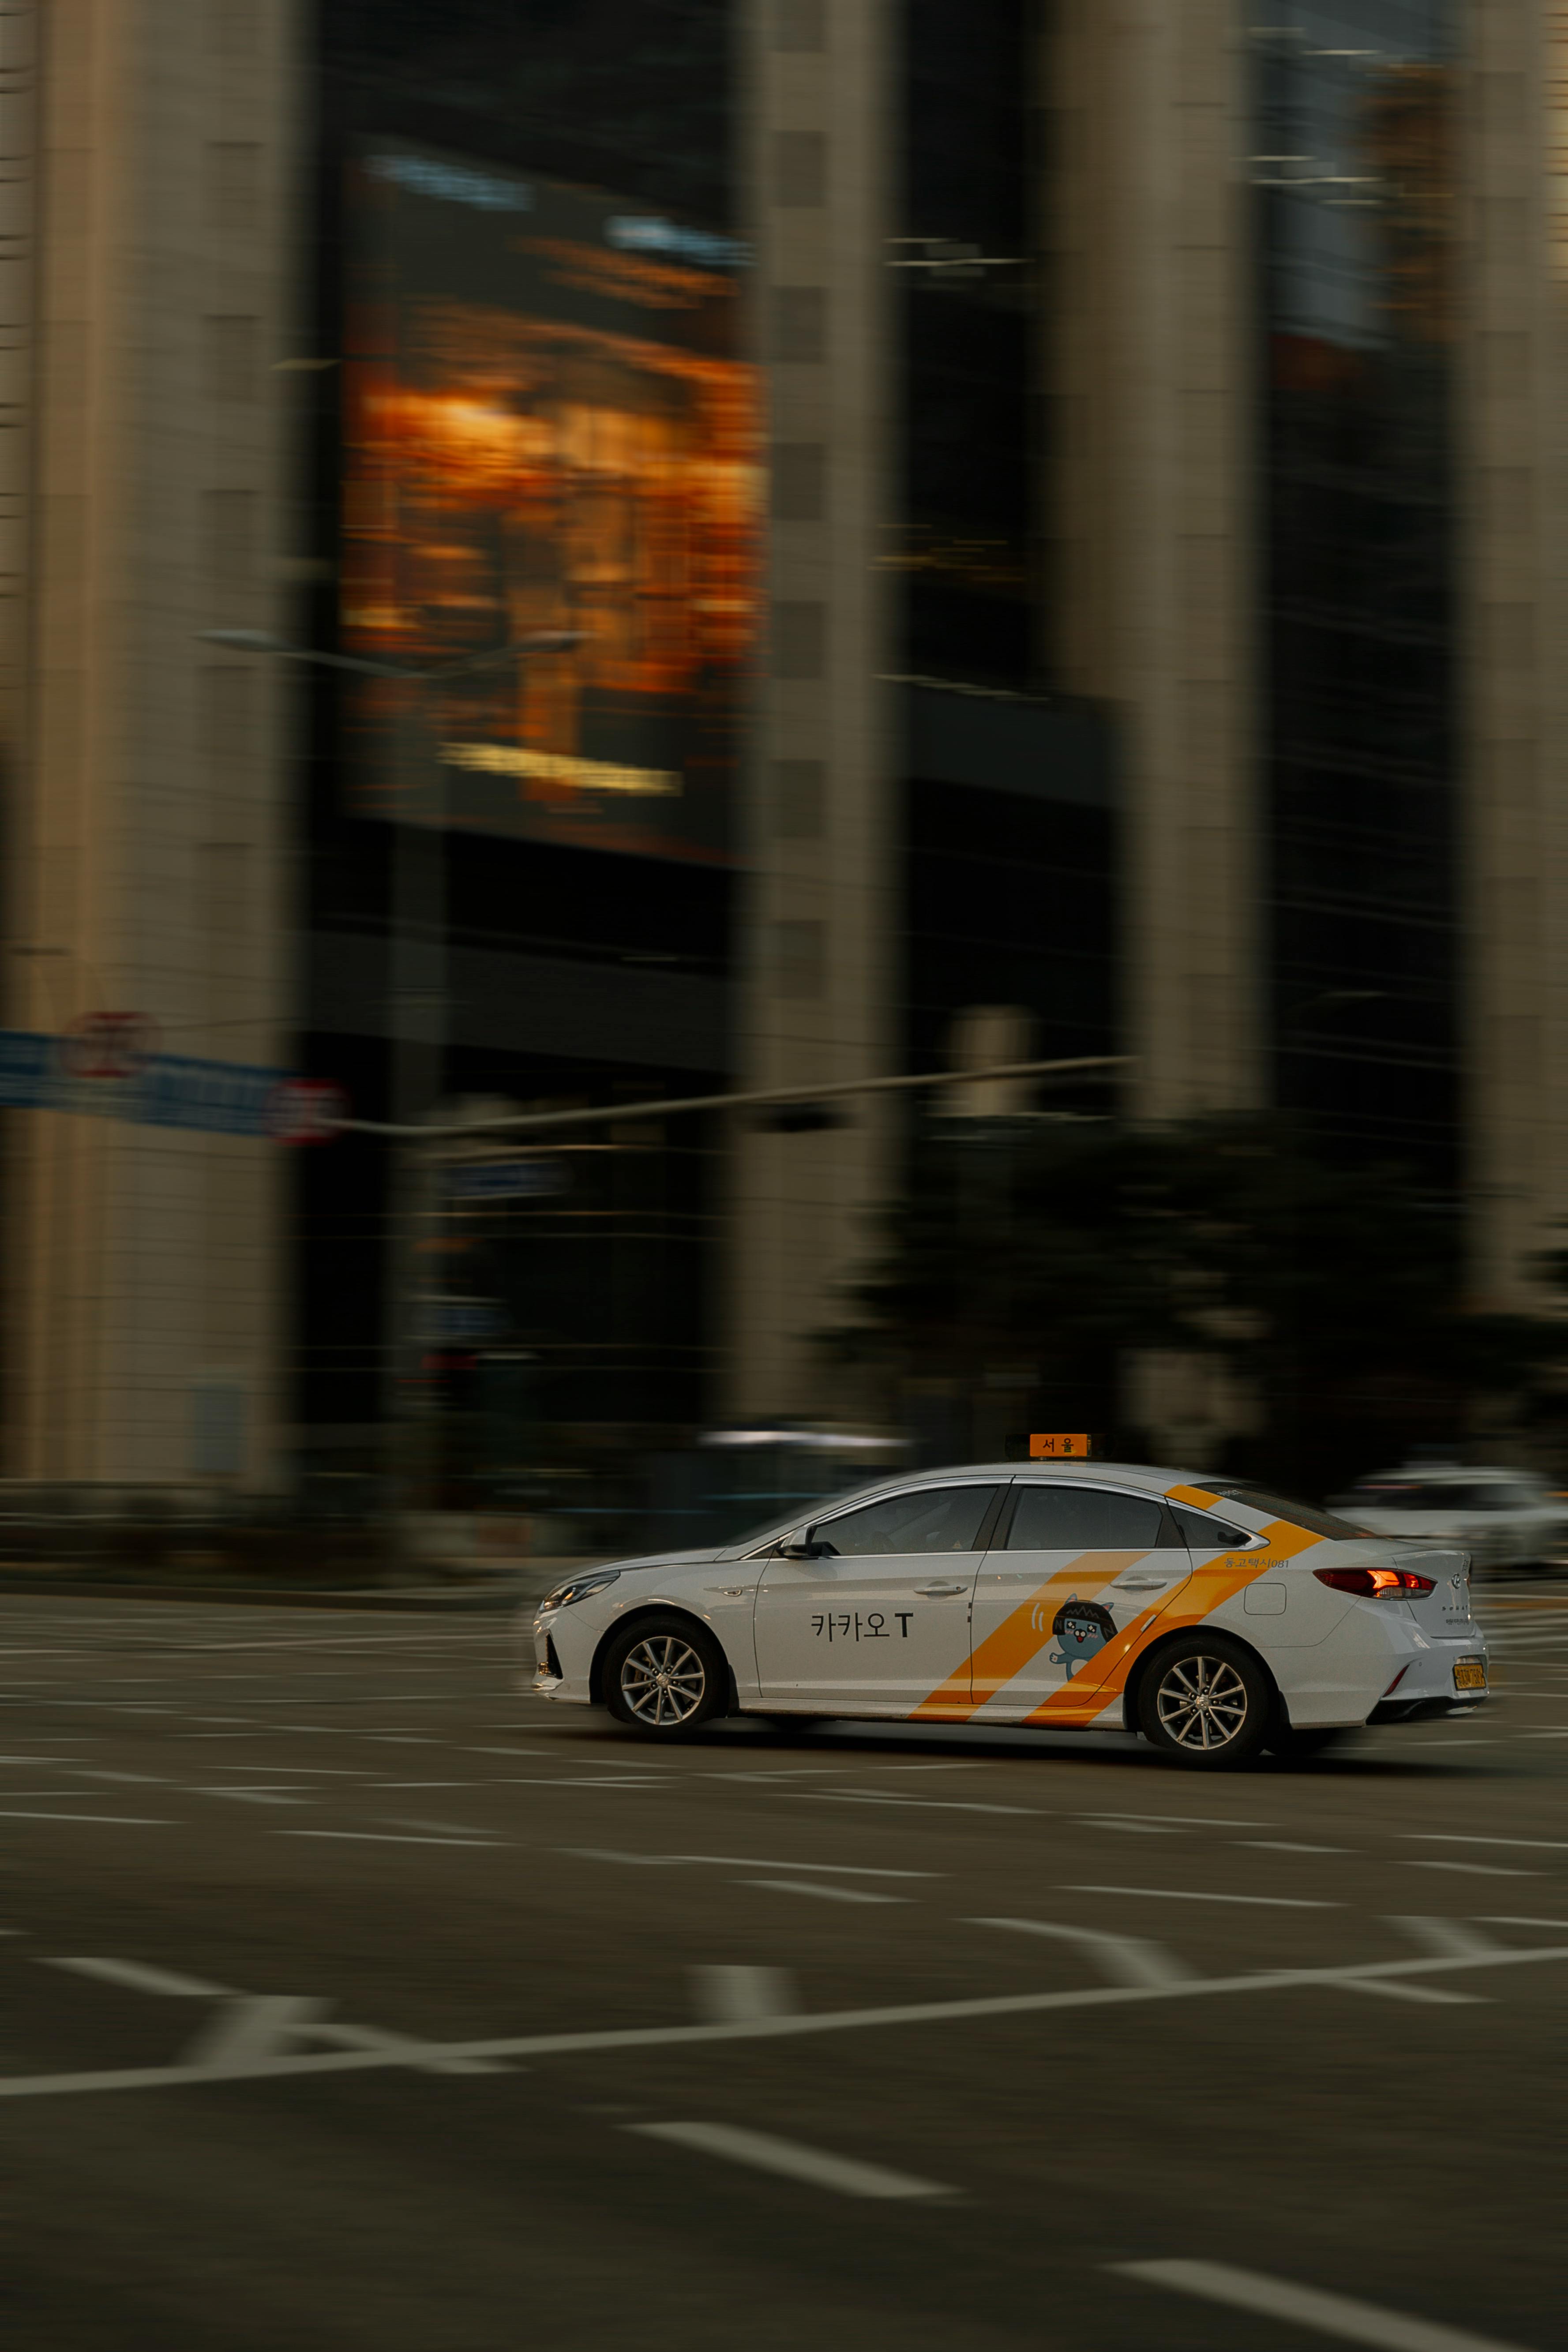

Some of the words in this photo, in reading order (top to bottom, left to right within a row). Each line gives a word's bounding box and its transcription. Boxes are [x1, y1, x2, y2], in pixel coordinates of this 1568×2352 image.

[1043, 1438, 1074, 1453] 서울
[811, 1612, 890, 1642] 카카오
[894, 1613, 914, 1638] T
